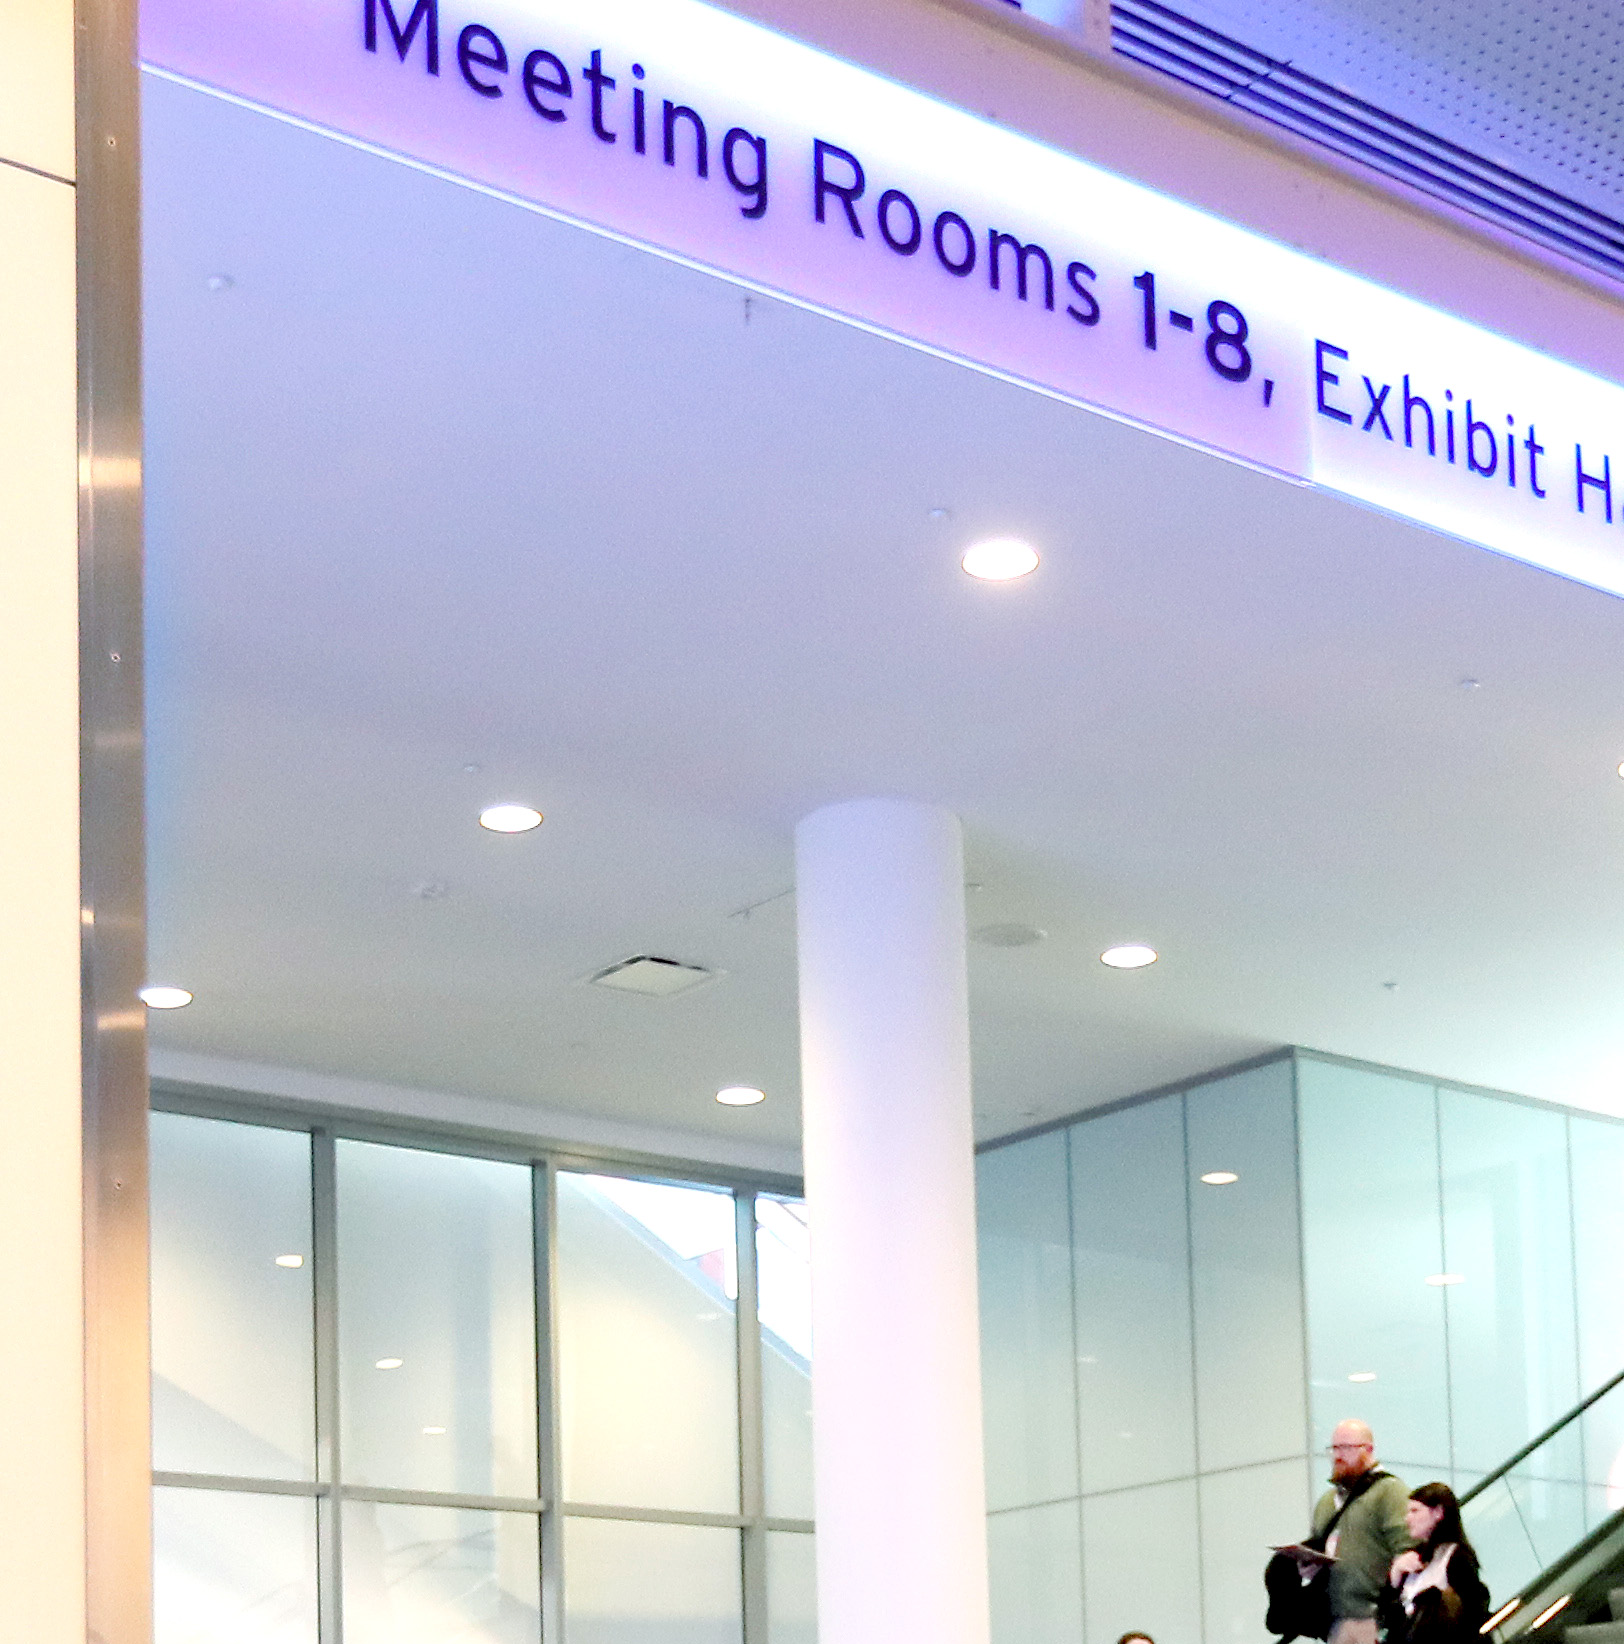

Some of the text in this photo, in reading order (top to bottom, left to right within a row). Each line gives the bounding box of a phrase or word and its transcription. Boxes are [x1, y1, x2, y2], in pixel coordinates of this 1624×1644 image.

[360, 0, 770, 222] Meeting
[811, 137, 1103, 330] Rooms
[1132, 270, 1276, 410] 1-8,
[1313, 337, 1548, 500] Exhibit
